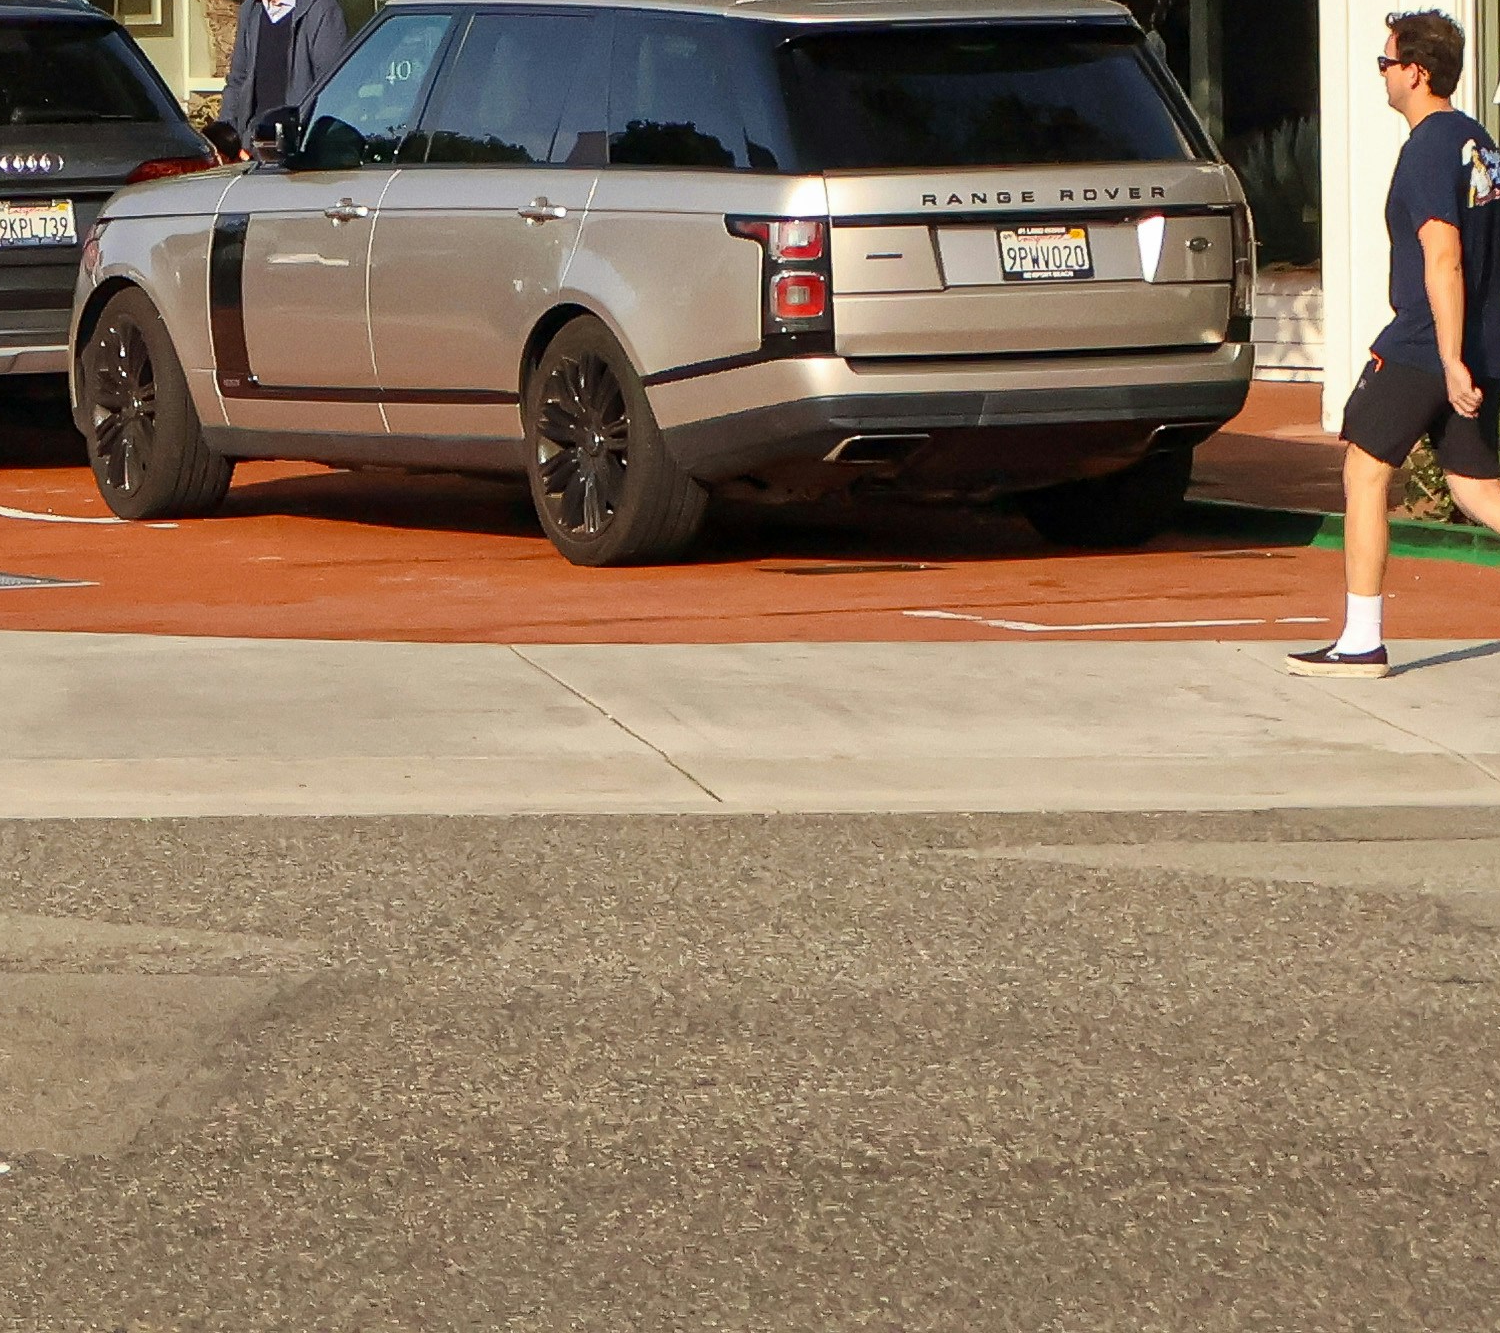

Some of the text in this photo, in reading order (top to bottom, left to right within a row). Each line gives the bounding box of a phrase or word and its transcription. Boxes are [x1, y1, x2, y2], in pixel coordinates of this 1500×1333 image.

[922, 186, 1166, 206] RANGE ROVER
[0, 217, 67, 239] 9KPL739
[1006, 245, 1086, 271] 9PWV020
